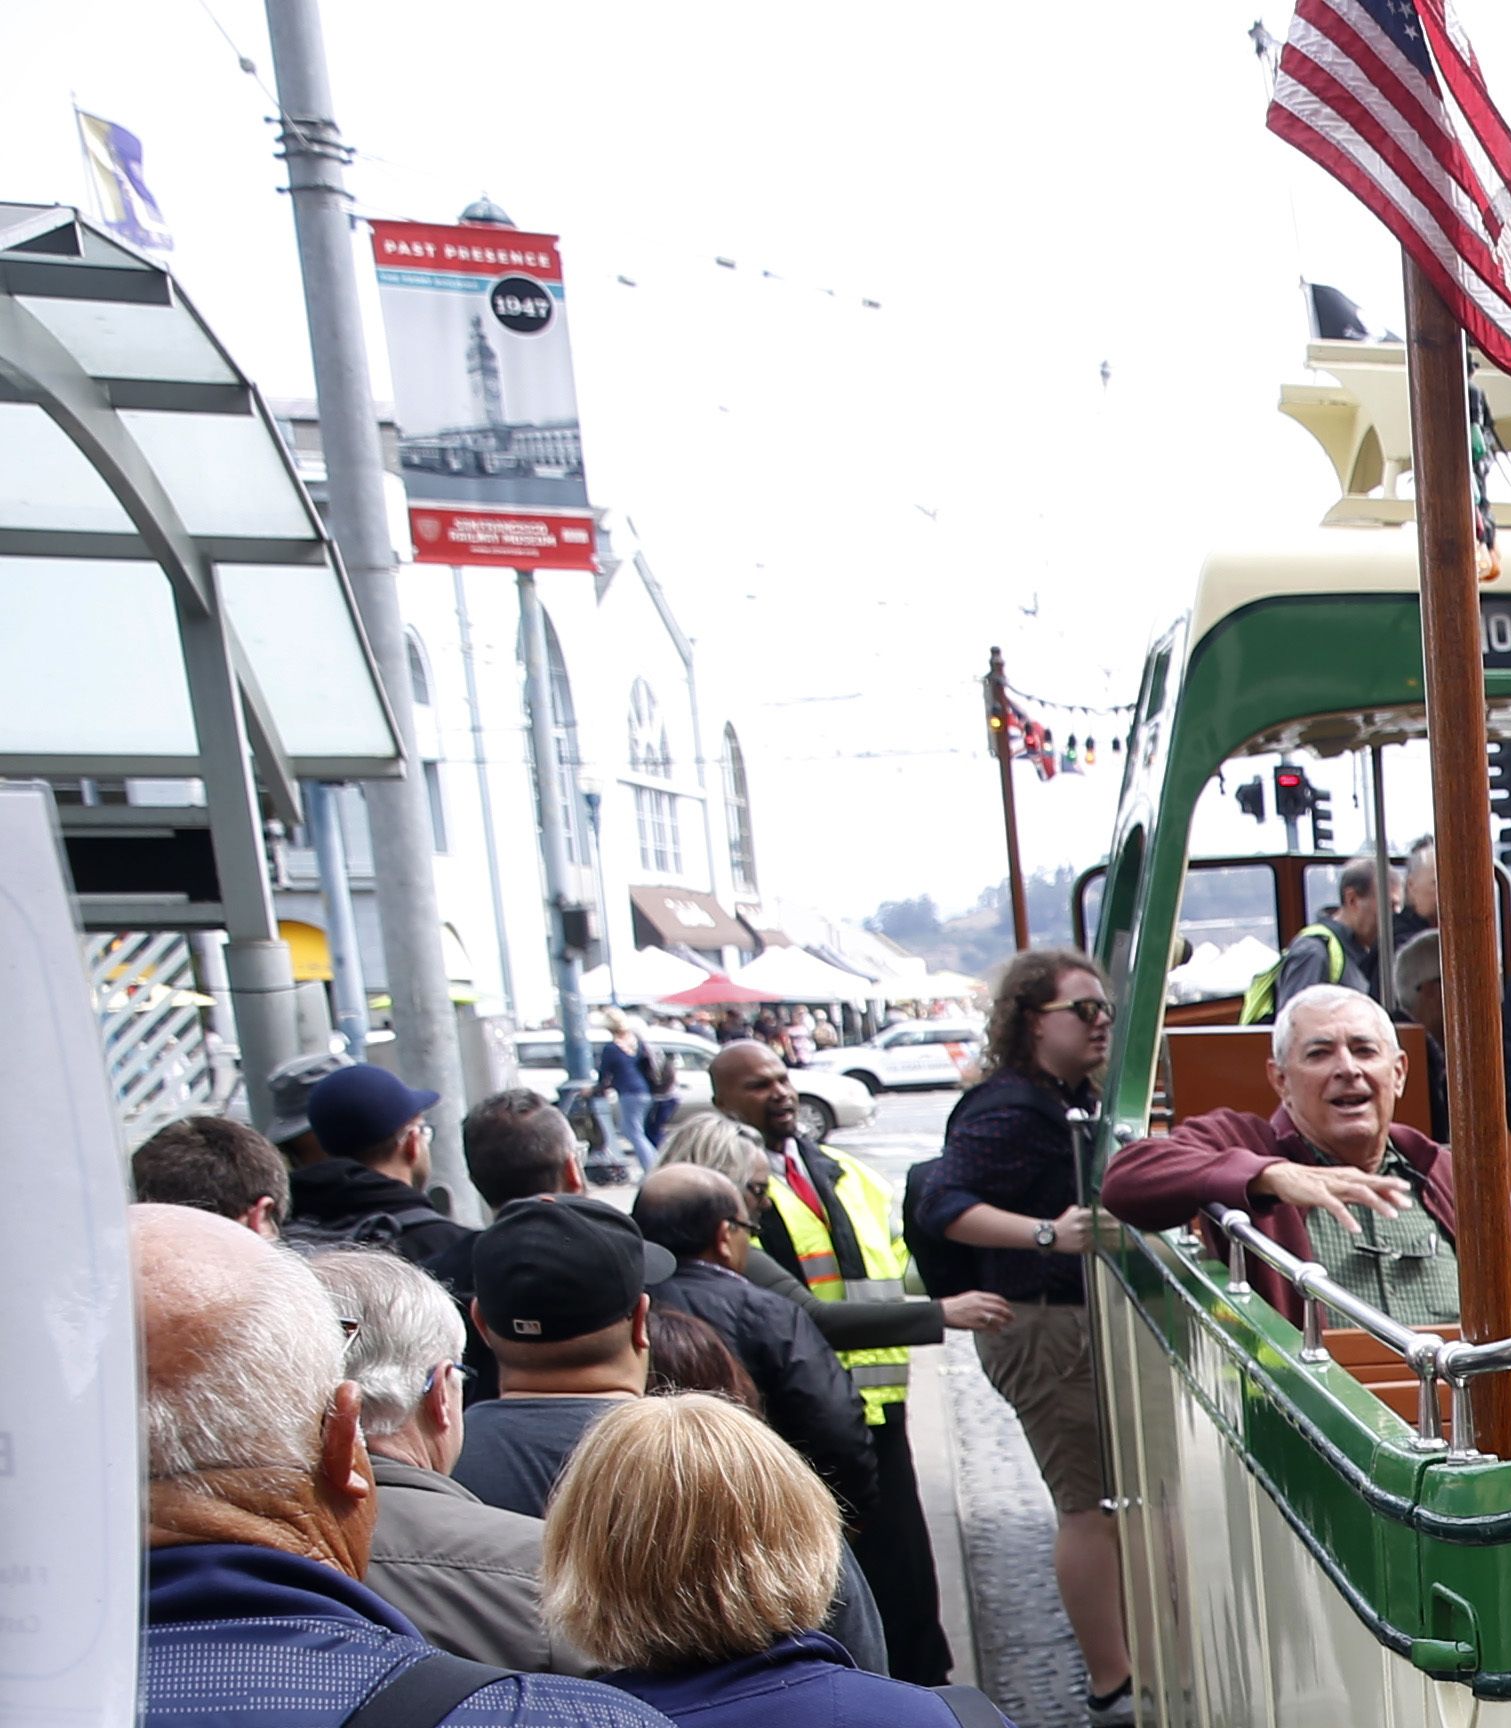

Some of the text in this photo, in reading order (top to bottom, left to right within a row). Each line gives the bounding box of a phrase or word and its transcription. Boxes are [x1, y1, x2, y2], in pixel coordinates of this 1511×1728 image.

[383, 239, 551, 269] PAST PRESENCE
[495, 295, 549, 318] 1947
